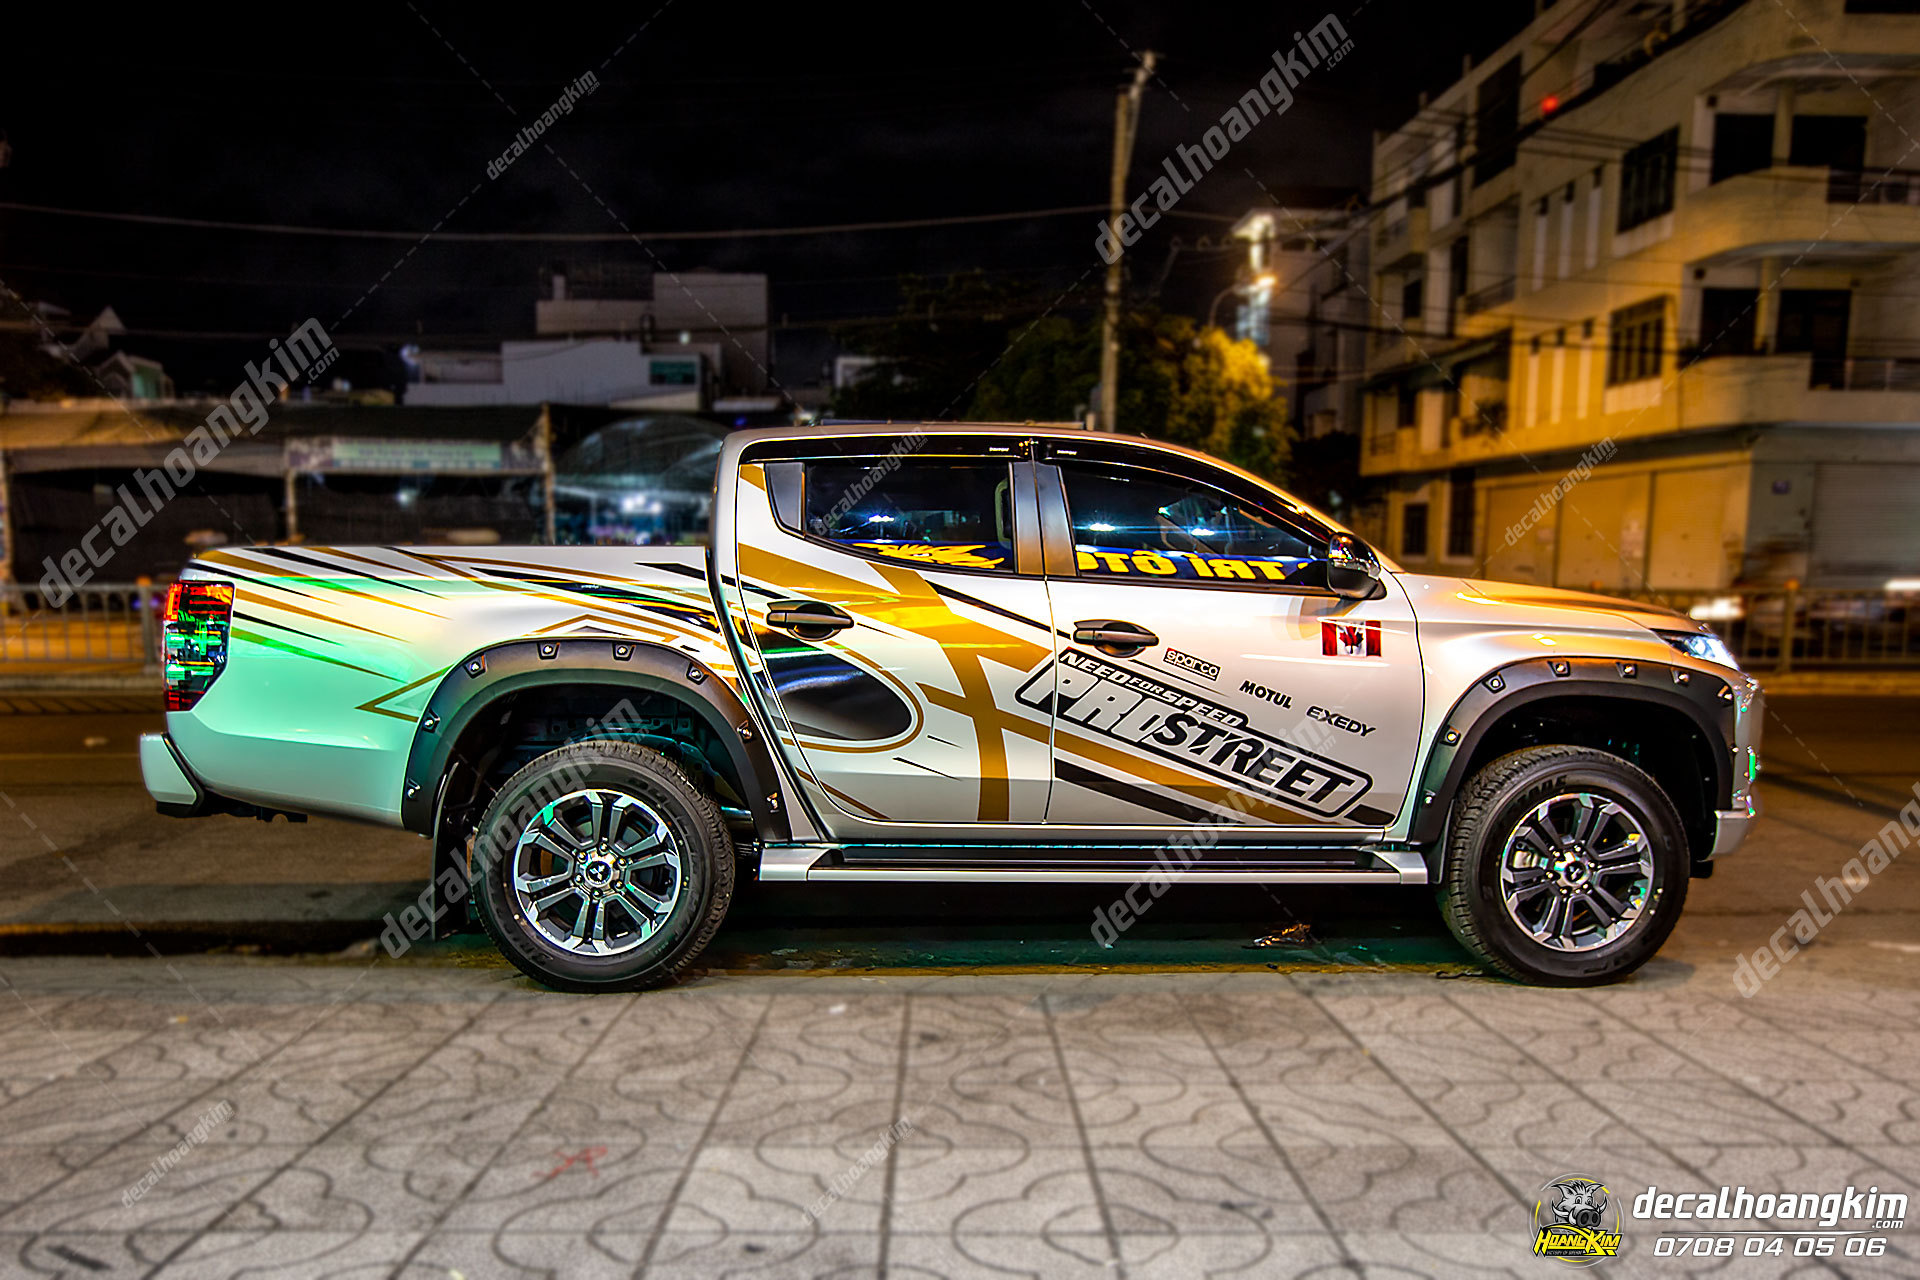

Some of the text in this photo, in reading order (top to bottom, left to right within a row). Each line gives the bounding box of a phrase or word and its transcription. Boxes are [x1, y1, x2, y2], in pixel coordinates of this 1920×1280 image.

[1166, 649, 1220, 679] sparco
[1239, 680, 1292, 709] MOTUL
[1306, 705, 1376, 738] EXEDY
